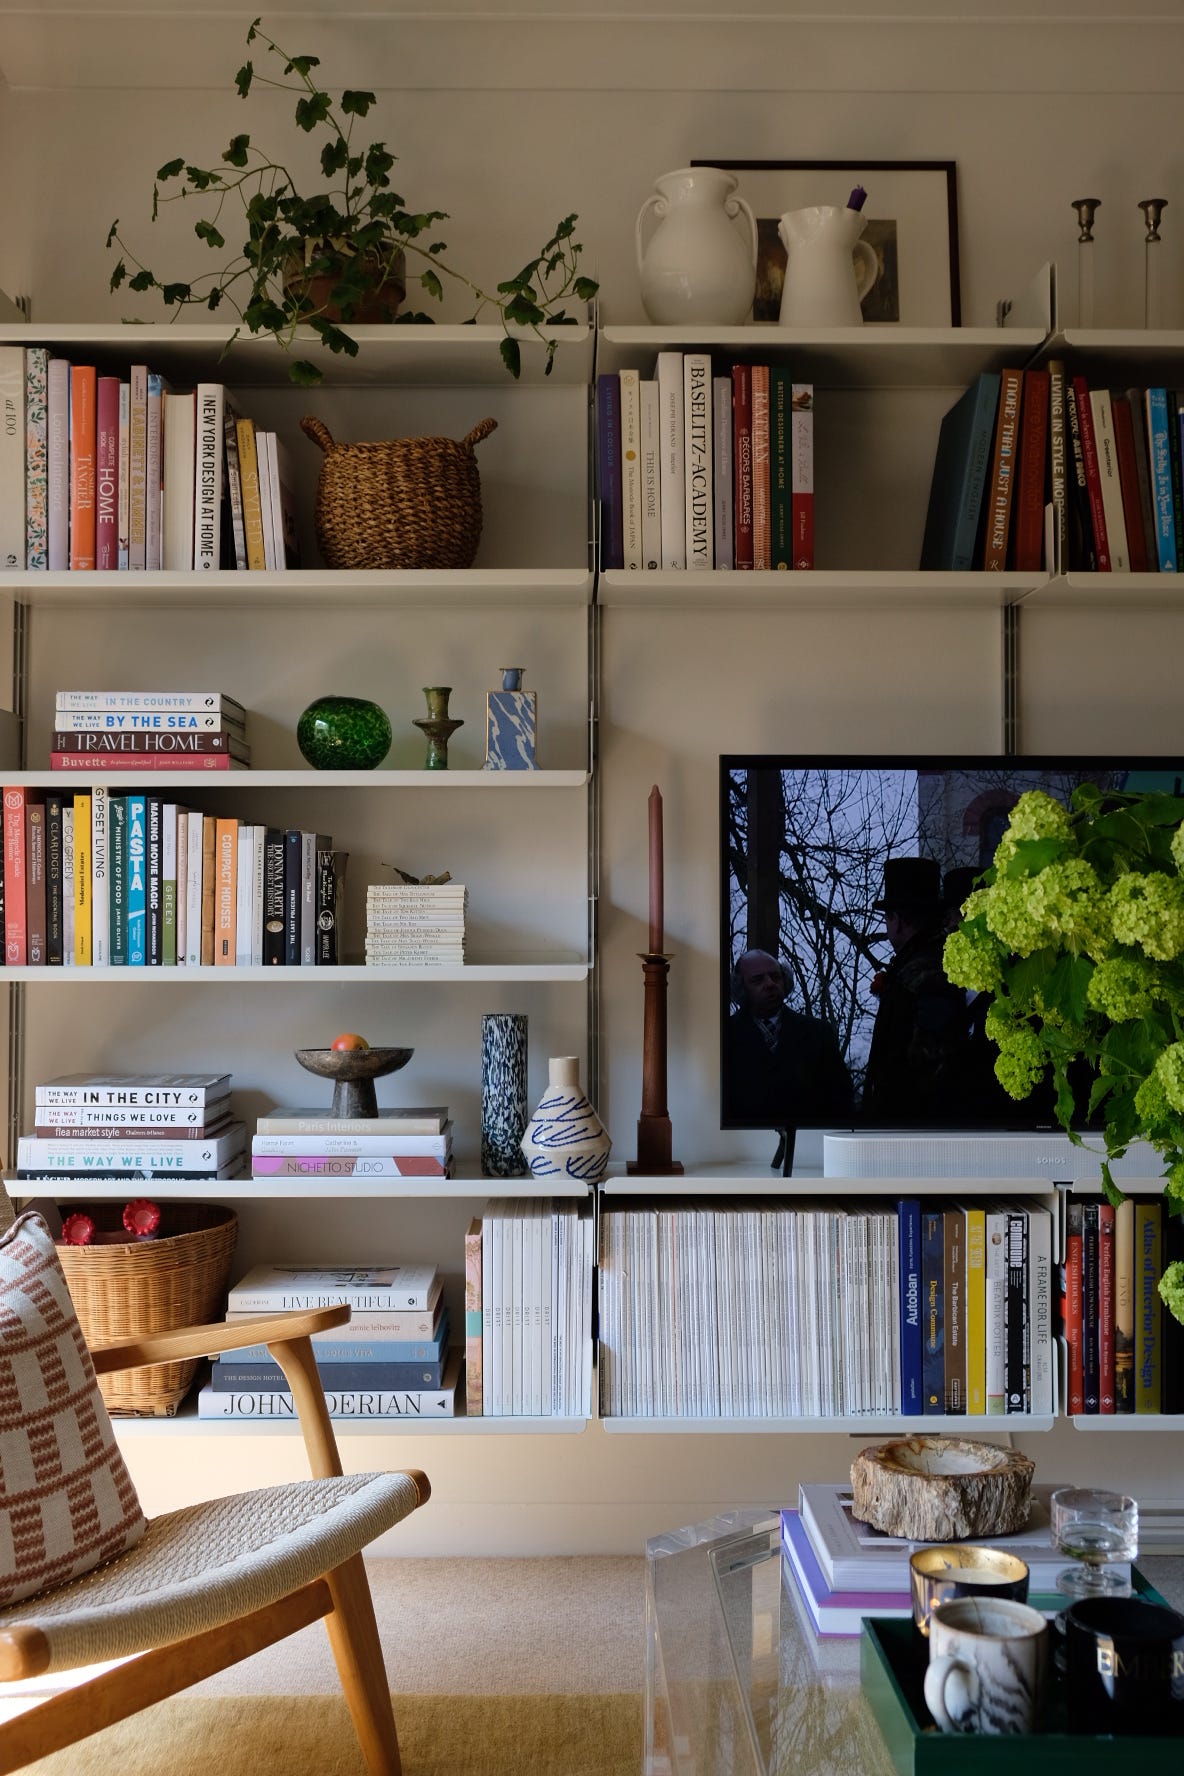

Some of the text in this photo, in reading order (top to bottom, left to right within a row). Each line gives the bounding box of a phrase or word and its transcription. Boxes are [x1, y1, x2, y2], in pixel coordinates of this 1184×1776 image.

[1051, 374, 1062, 415] LIVING
[6, 400, 16, 436] at 100
[607, 419, 613, 428] IN
[754, 392, 769, 464] RATTAN
[1053, 419, 1062, 432] IN
[132, 408, 145, 473] KABINETT
[1026, 380, 1045, 511] Pierre Yovanovitch
[1053, 436, 1063, 474] STYLE
[1103, 438, 1113, 478] Greenterior
[54, 413, 64, 512] London Interiors
[201, 400, 215, 556] NEW YORK DESIGN AT HOME
[778, 456, 784, 464] AT
[967, 431, 987, 521] MODERN ENGLISH
[993, 378, 1018, 549] MORE THAN JUST A HOUSE
[77, 454, 92, 510] TANGIER
[100, 469, 114, 523] HOME
[132, 476, 144, 485] &
[647, 477, 654, 485] IS
[742, 437, 751, 524] DÉCORS BARBARES
[132, 489, 144, 544] KAMMER
[243, 472, 261, 544] STYLED
[647, 487, 655, 517] HOME
[106, 716, 198, 727] BY THE SEA
[75, 734, 140, 751] TRAVEL
[145, 734, 204, 751] HOME
[62, 757, 106, 767] Buvette
[96, 788, 104, 878] GYPSET LIVING
[150, 803, 158, 841] MAKING
[65, 826, 73, 880] GO GREEN
[130, 803, 144, 891] PASTA
[150, 844, 158, 875] MOVIE
[115, 867, 121, 878] OF
[221, 834, 232, 928] COMPACT HOUSES
[274, 844, 283, 916] DONNA TARTT
[84, 1093, 181, 1103] IN THE CITY
[56, 1128, 120, 1137] flea market style
[298, 1122, 371, 1132] Paris Interiors
[48, 1157, 183, 1166] THE WAY WE LIVE
[288, 1163, 383, 1172] NICHETTO STUDIO
[1036, 1156, 1066, 1165] SONOS
[1009, 1220, 1023, 1267] commune
[283, 1296, 395, 1308] LIVE BEAUTIFUL
[906, 1273, 918, 1325] Autoban
[929, 1280, 937, 1307] Design
[1037, 1266, 1047, 1301] FRAME
[1102, 1242, 1111, 1336] Perfect English Farmhouse
[1037, 1302, 1047, 1321] FOR
[1141, 1217, 1156, 1389] Atlas of Interior Design
[1037, 1324, 1047, 1344] LIFE
[224, 1394, 294, 1415] JOHN
